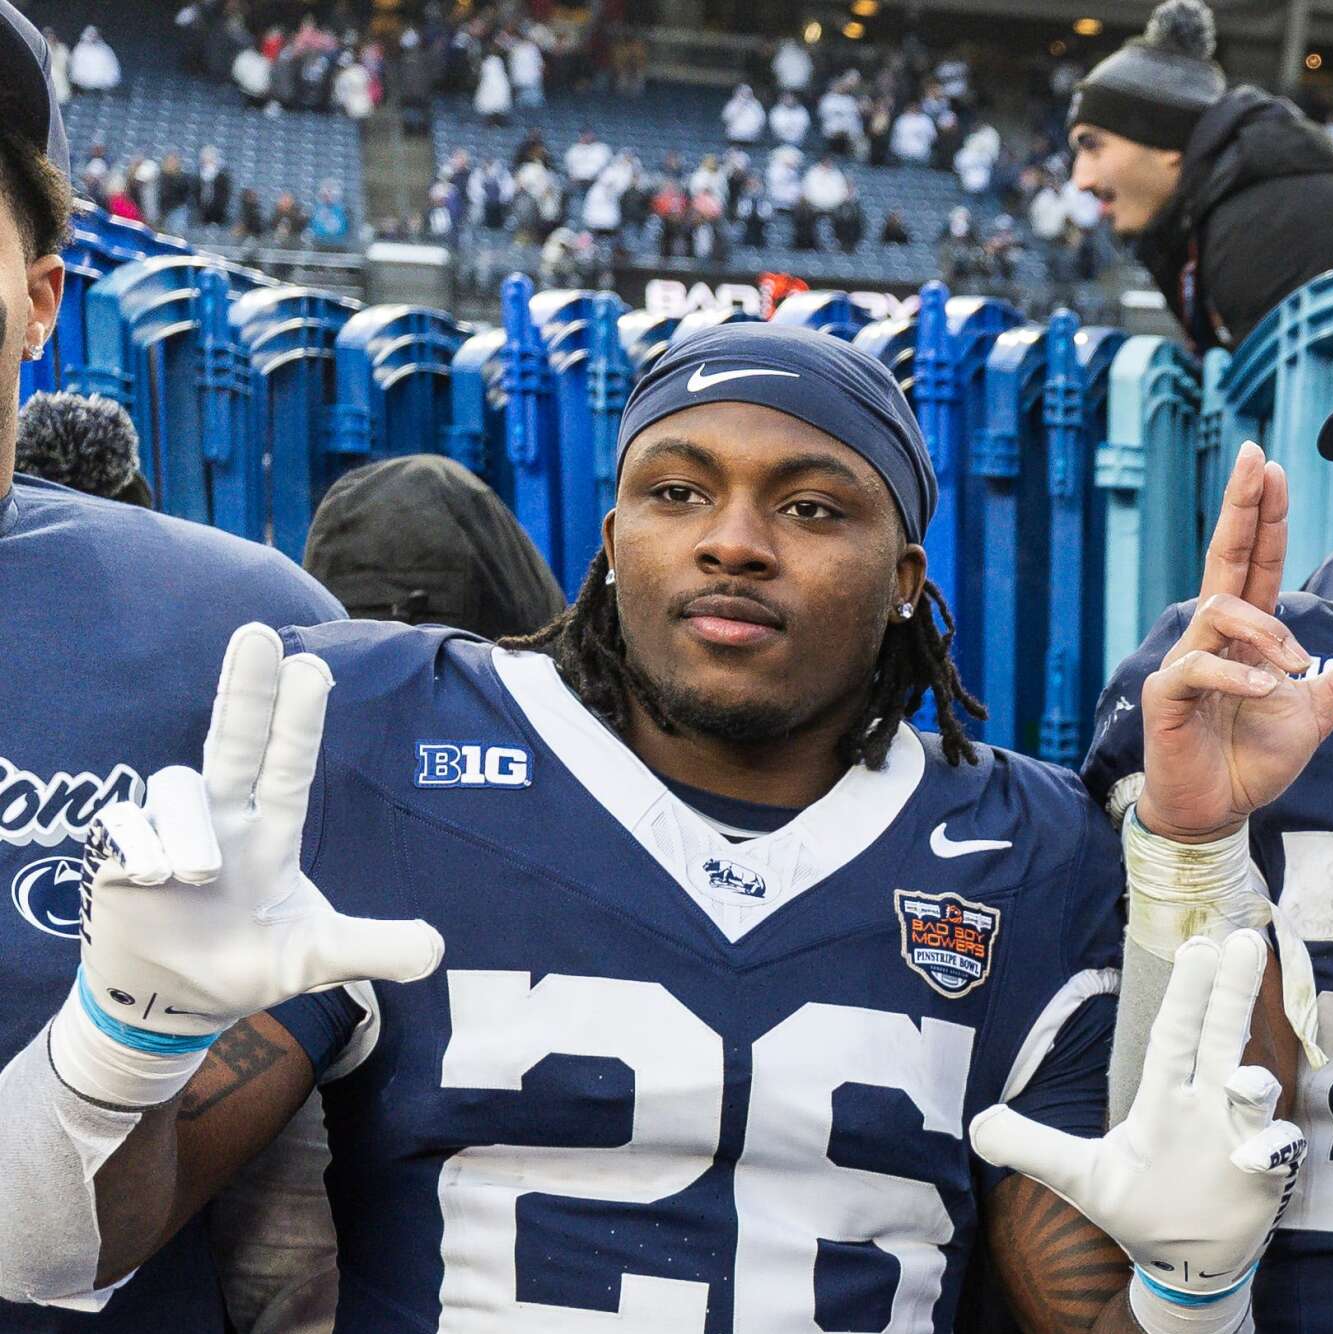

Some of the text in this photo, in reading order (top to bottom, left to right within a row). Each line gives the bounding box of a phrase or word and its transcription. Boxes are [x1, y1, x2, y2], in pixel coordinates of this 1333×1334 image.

[912, 919, 948, 935] BAD
[954, 926, 985, 943] BOY
[912, 932, 985, 957] MOWERS
[917, 950, 957, 966] PINSTRIPE
[959, 957, 980, 975] BOWL
